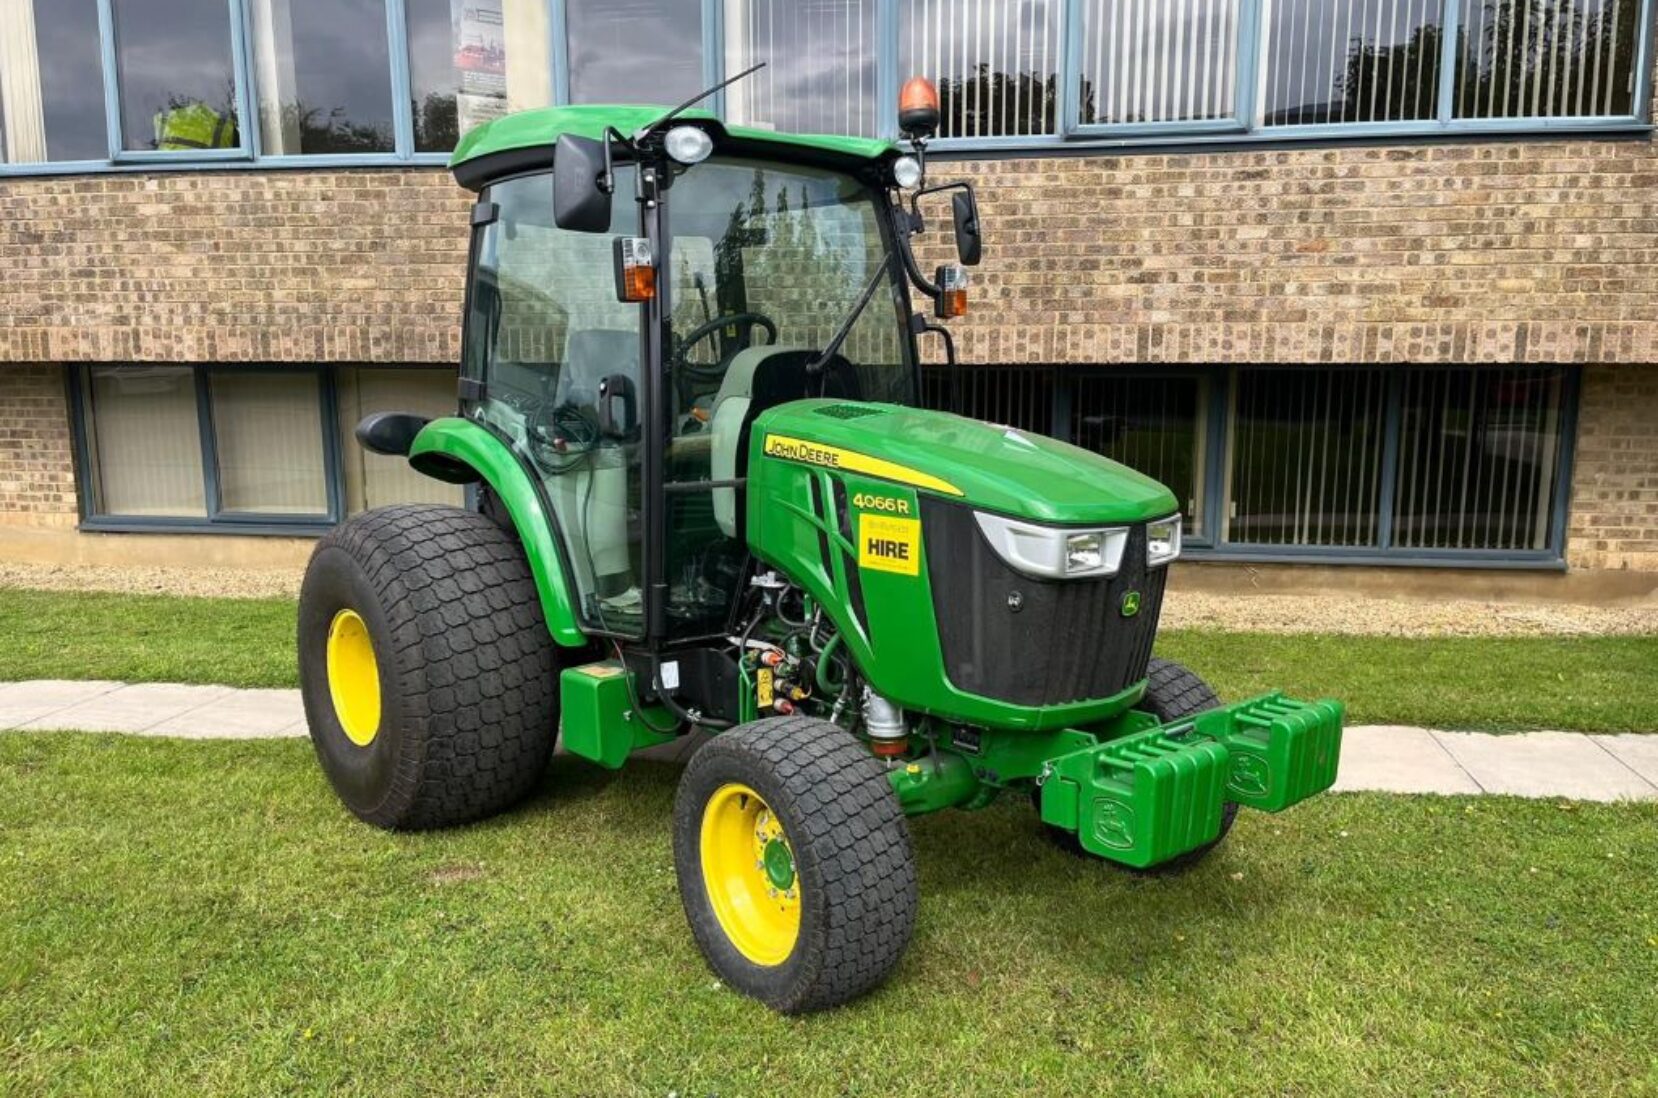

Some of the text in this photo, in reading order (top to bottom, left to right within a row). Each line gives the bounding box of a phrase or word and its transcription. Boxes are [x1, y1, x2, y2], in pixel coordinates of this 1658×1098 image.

[768, 439, 840, 466] JOHN DEERE
[868, 537, 909, 561] HIRE
